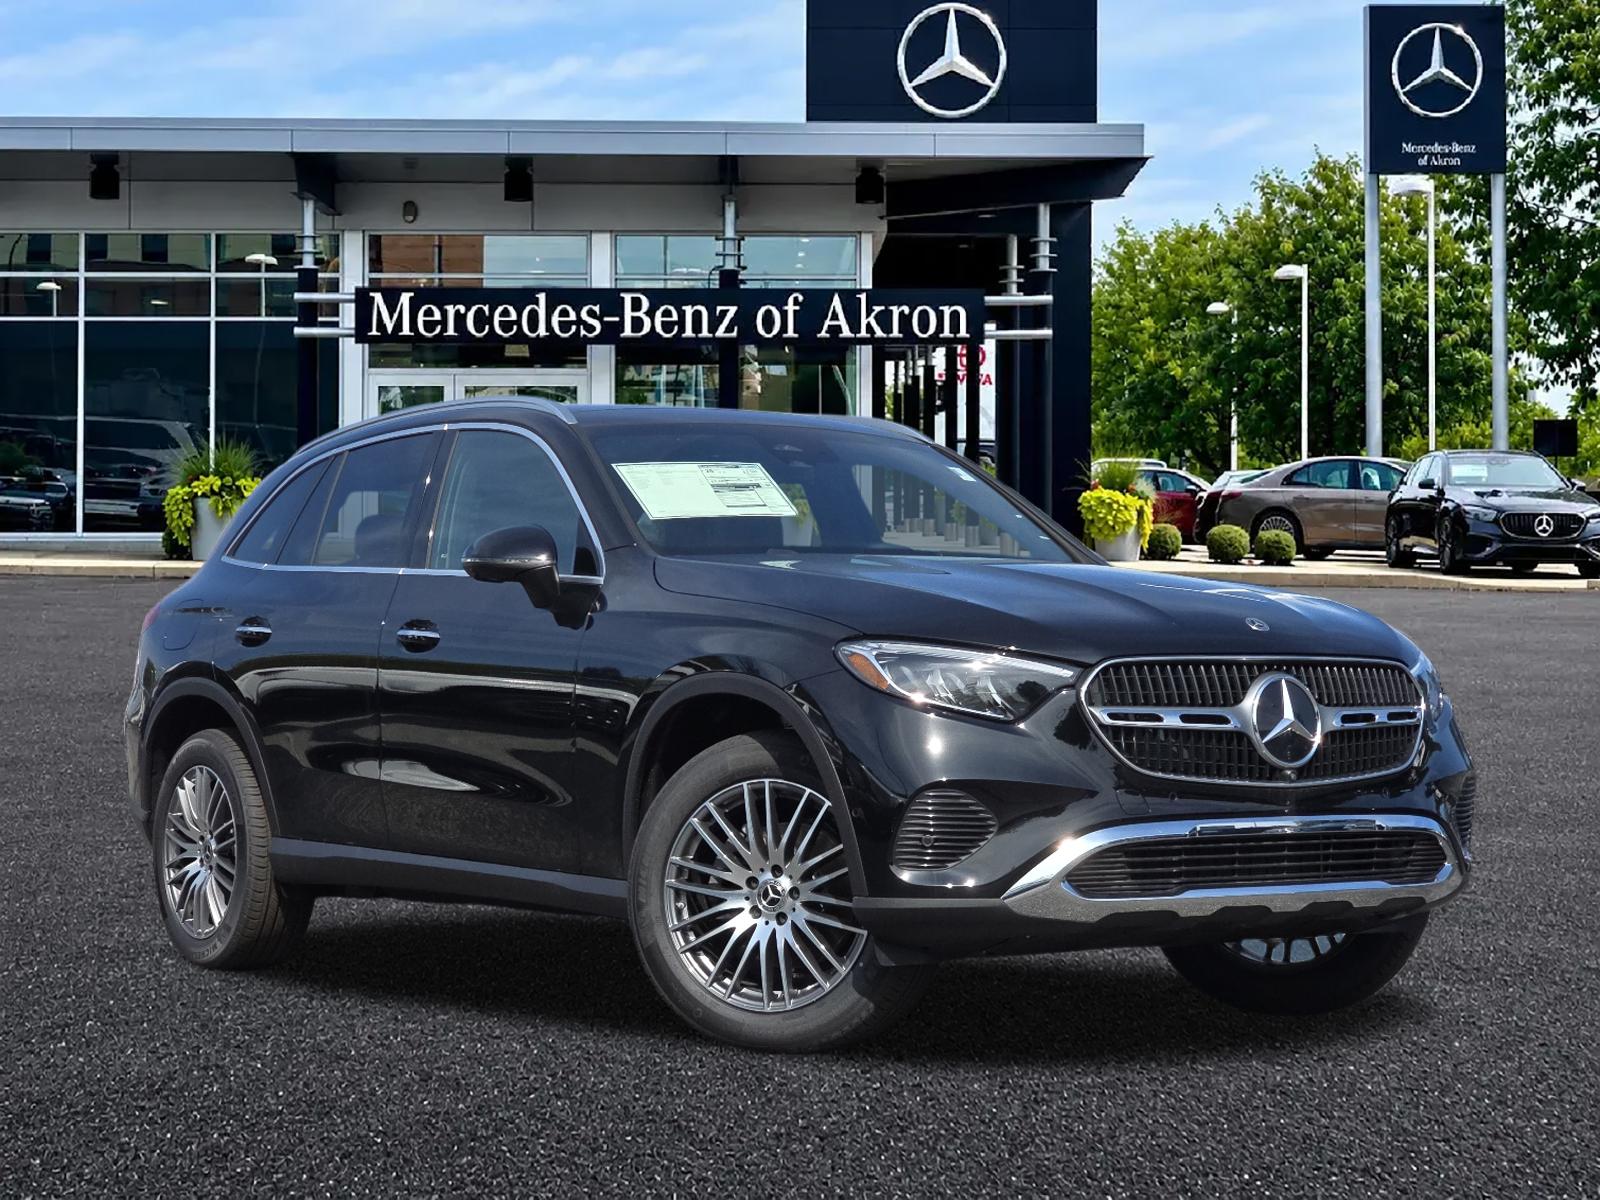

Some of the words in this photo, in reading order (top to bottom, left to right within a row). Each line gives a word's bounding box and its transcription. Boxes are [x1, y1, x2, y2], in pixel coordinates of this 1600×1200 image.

[1401, 142, 1477, 154] Mercedes-Benz
[1417, 154, 1428, 166] of
[1430, 154, 1461, 166] Akron
[367, 291, 738, 338] Mercedes-Benz
[755, 292, 804, 338] of
[816, 291, 971, 338] Akron
